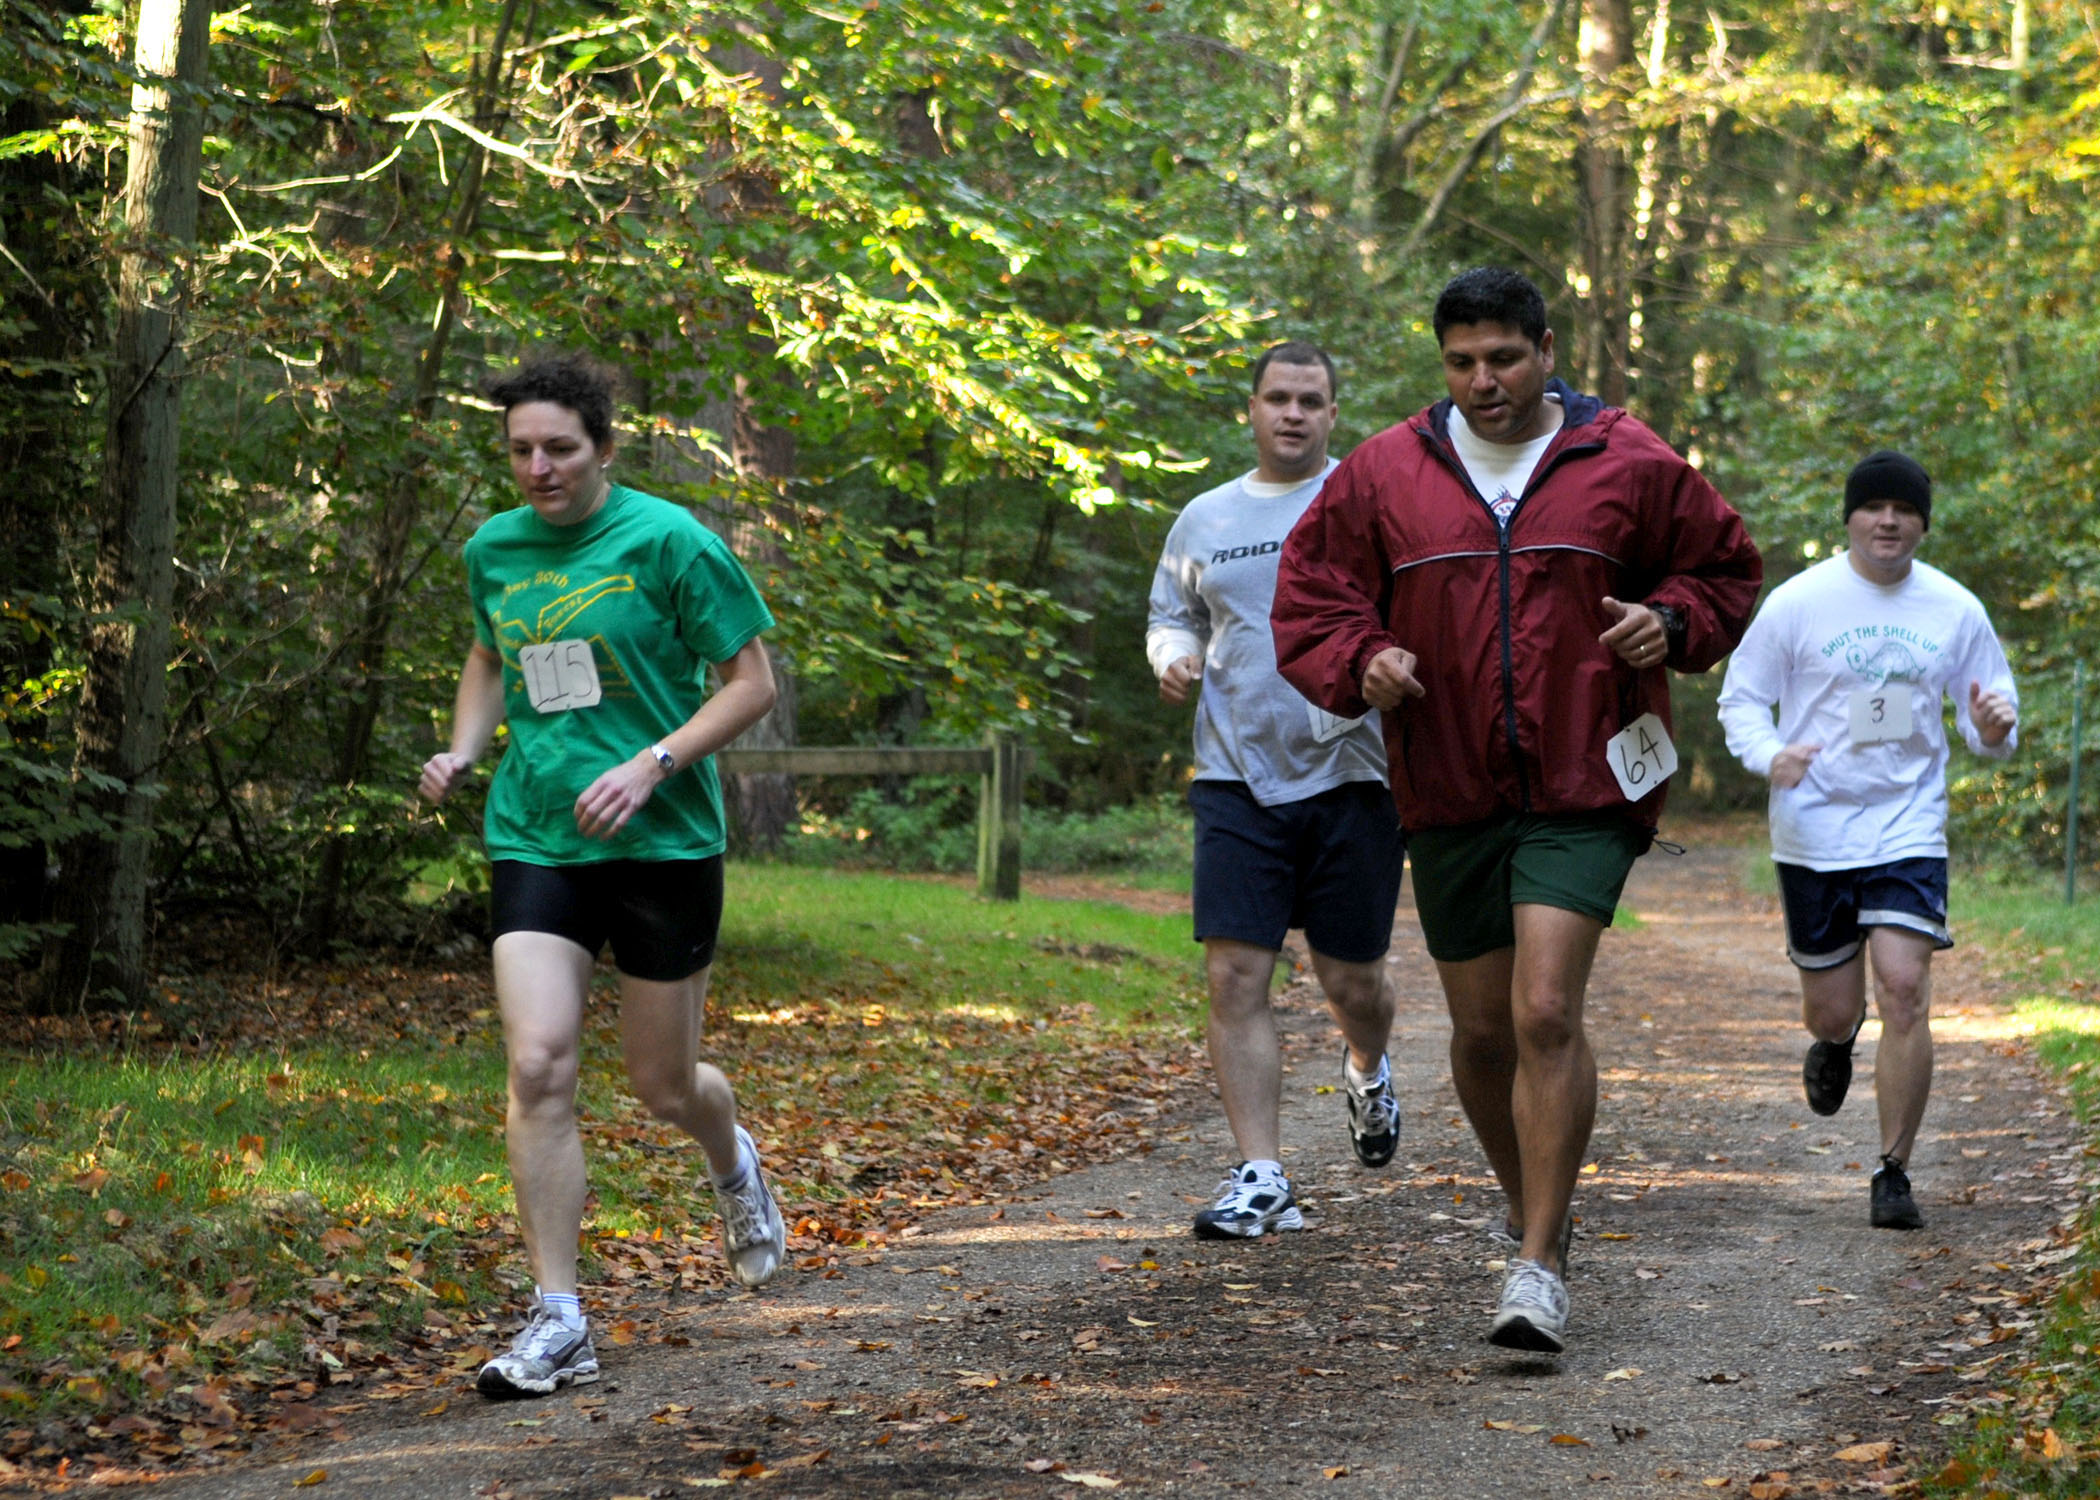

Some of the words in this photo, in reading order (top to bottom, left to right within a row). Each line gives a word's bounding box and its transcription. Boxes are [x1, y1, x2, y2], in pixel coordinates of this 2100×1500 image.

[1822, 631, 1850, 658] SHUT
[1854, 625, 1879, 640] THE
[1883, 625, 1919, 644] SHELL
[526, 644, 594, 710] 115
[1870, 697, 1885, 723] 3
[1620, 726, 1662, 785] 64
